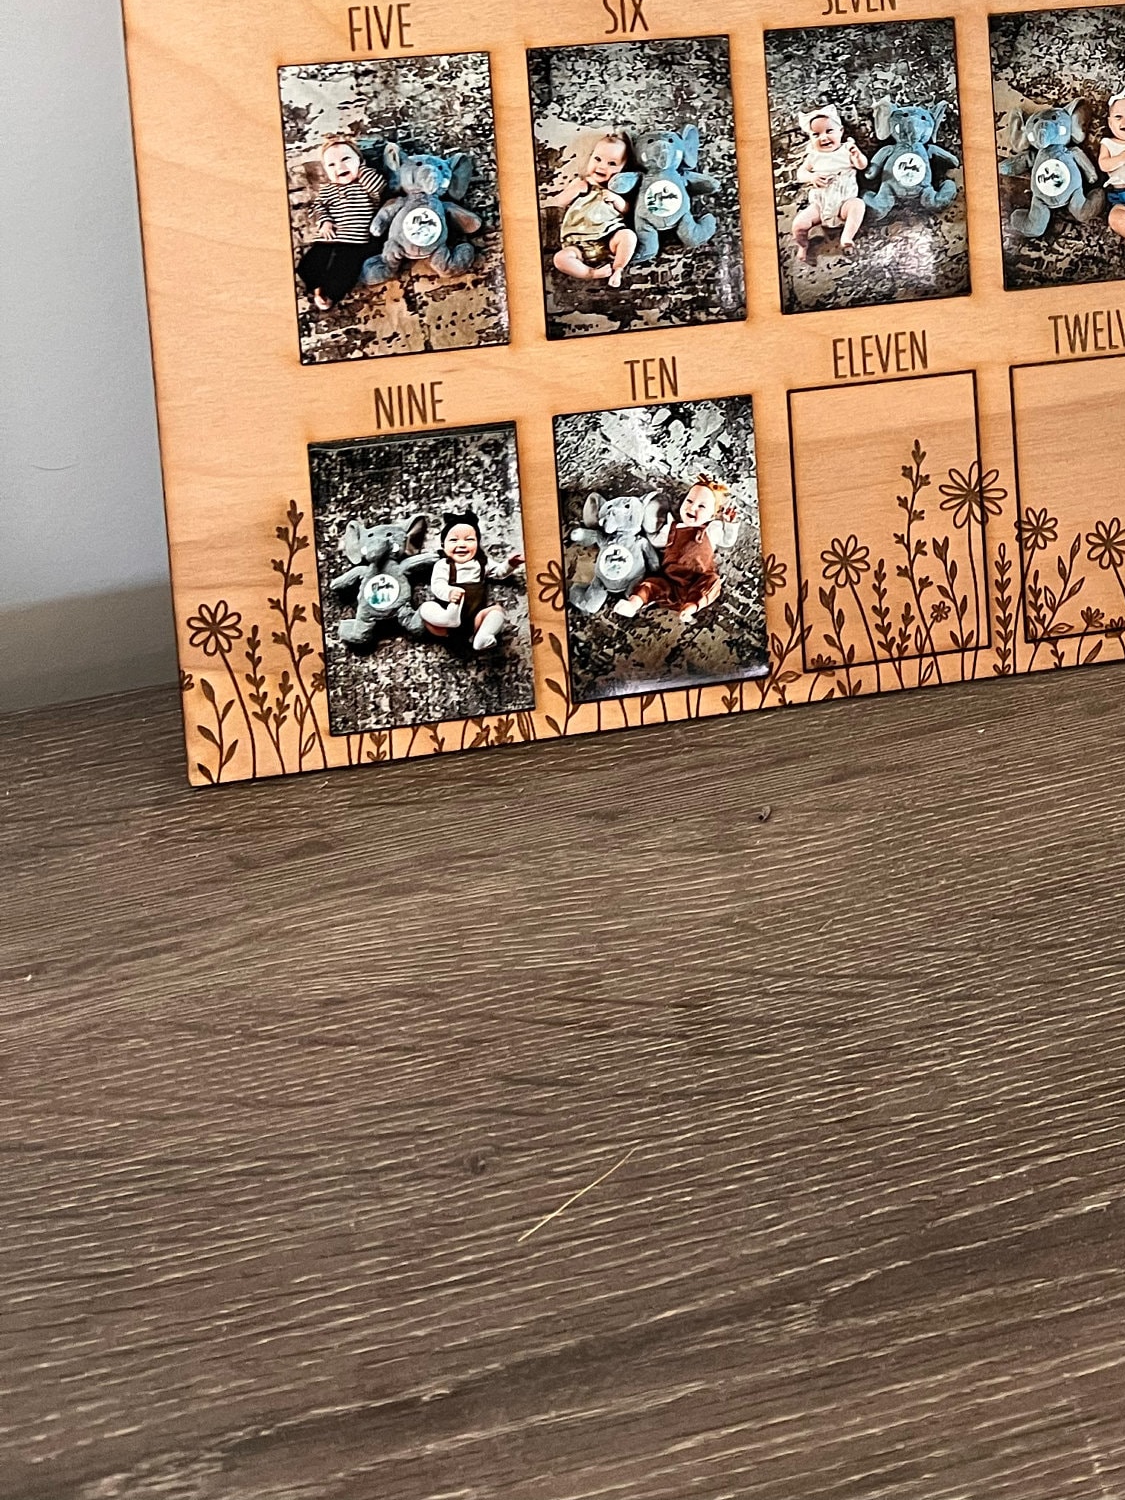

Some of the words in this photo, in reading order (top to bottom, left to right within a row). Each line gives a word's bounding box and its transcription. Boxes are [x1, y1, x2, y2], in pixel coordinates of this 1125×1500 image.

[347, 2, 415, 53] FIVE
[623, 355, 679, 402] TEN
[832, 329, 928, 380] ELEVEN
[373, 380, 446, 430] NINE
